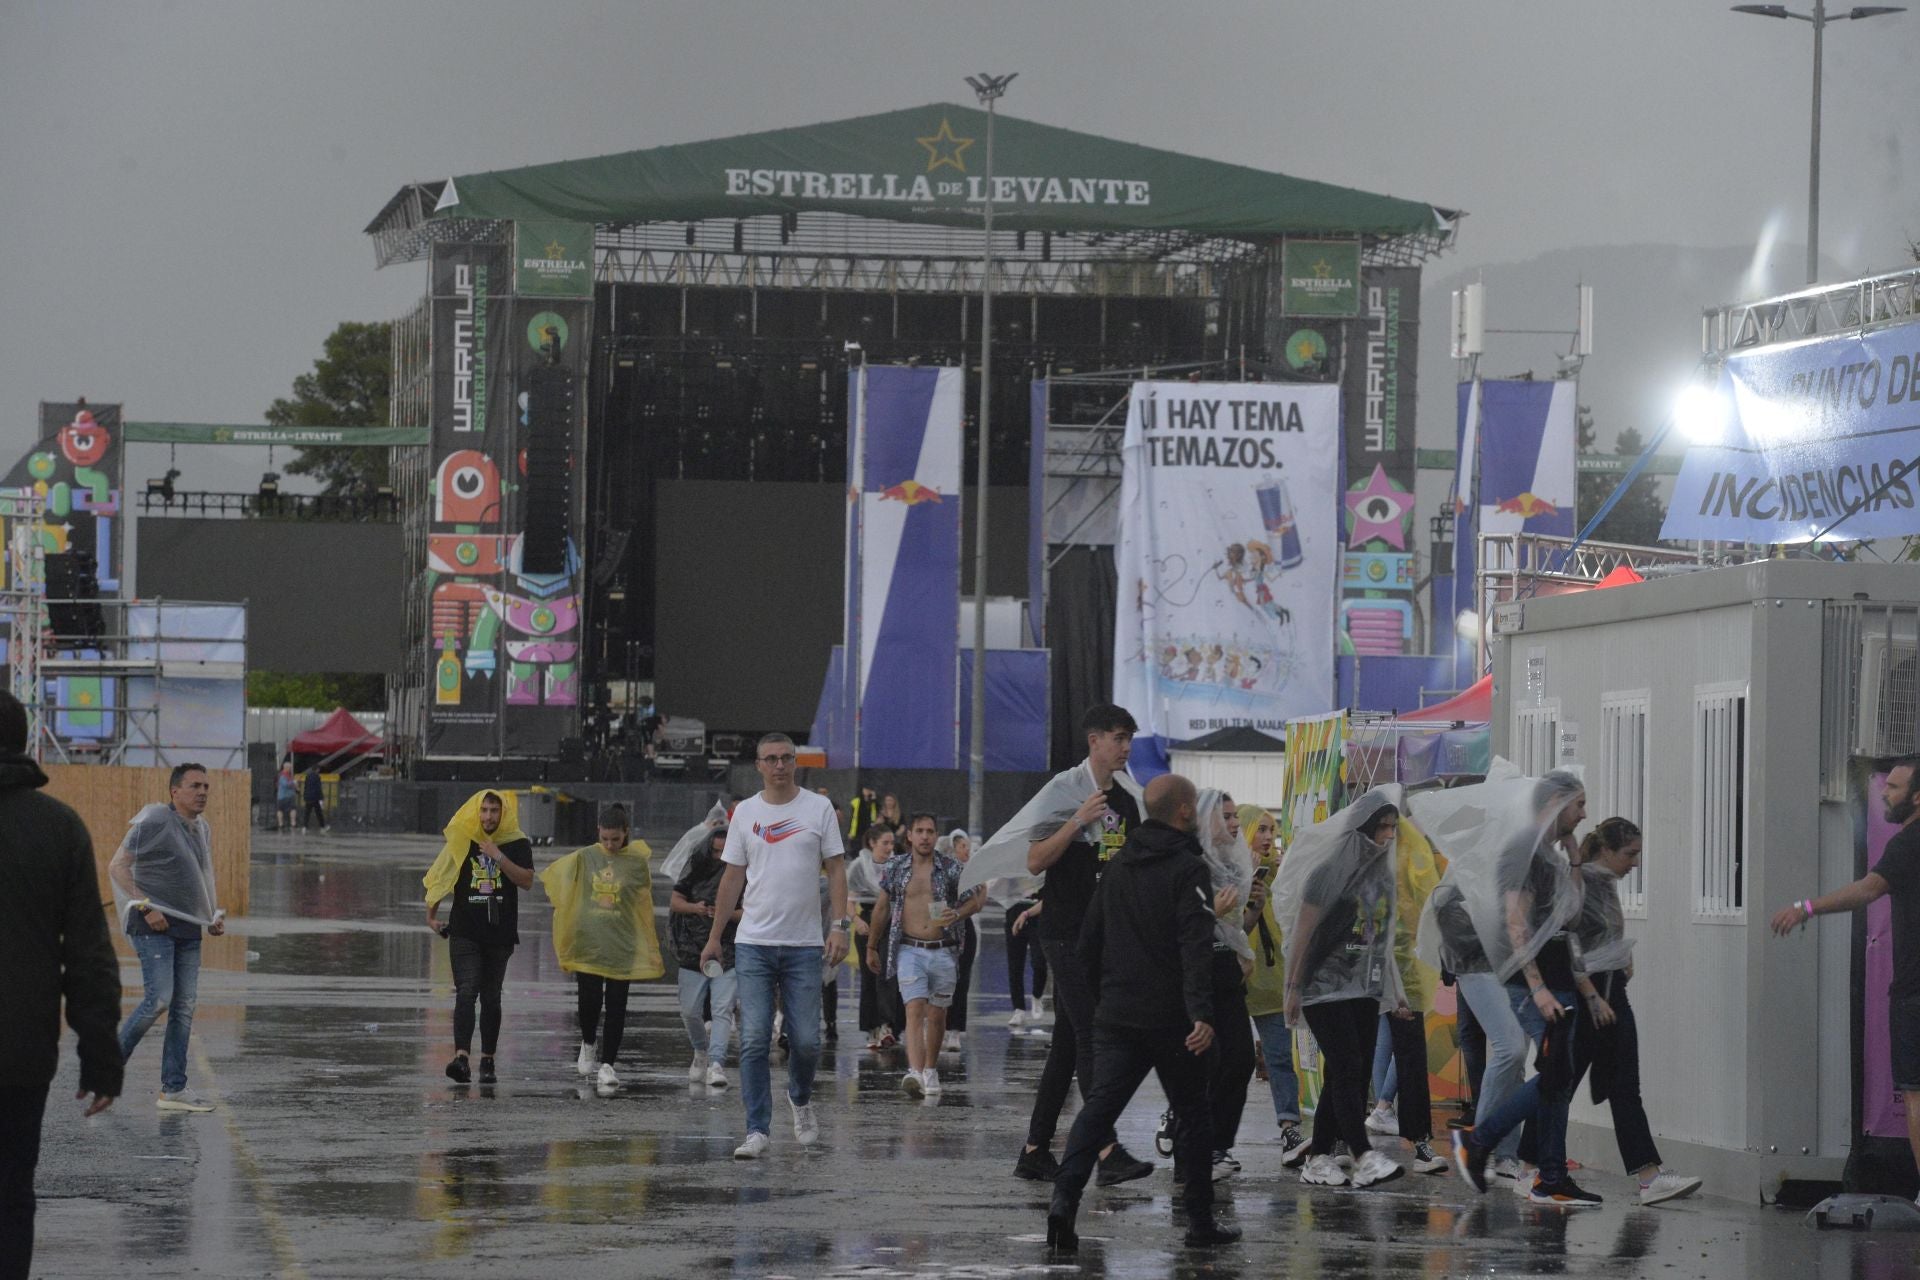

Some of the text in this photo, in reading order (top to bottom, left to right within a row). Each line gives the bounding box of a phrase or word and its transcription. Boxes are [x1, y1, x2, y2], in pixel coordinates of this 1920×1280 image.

[725, 168, 1150, 206] ESTRELLA DE LEVANTE
[524, 258, 585, 269] ESTRELLA
[474, 265, 488, 337] LEVANTE
[1291, 278, 1352, 288] ESTRELLA
[1387, 287, 1399, 358] LEVANTE
[474, 351, 486, 432] ESTRELLA
[1167, 399, 1221, 430] HAY
[1228, 400, 1304, 432] TEMA
[1385, 371, 1397, 451] ESTRELLA
[233, 431, 287, 441] ESTRELLA
[295, 431, 343, 441] LEVANTE
[1147, 435, 1283, 469] TEMAZOS.
[1699, 459, 1915, 522] INCIDENCIAS
[1189, 719, 1206, 730] RED
